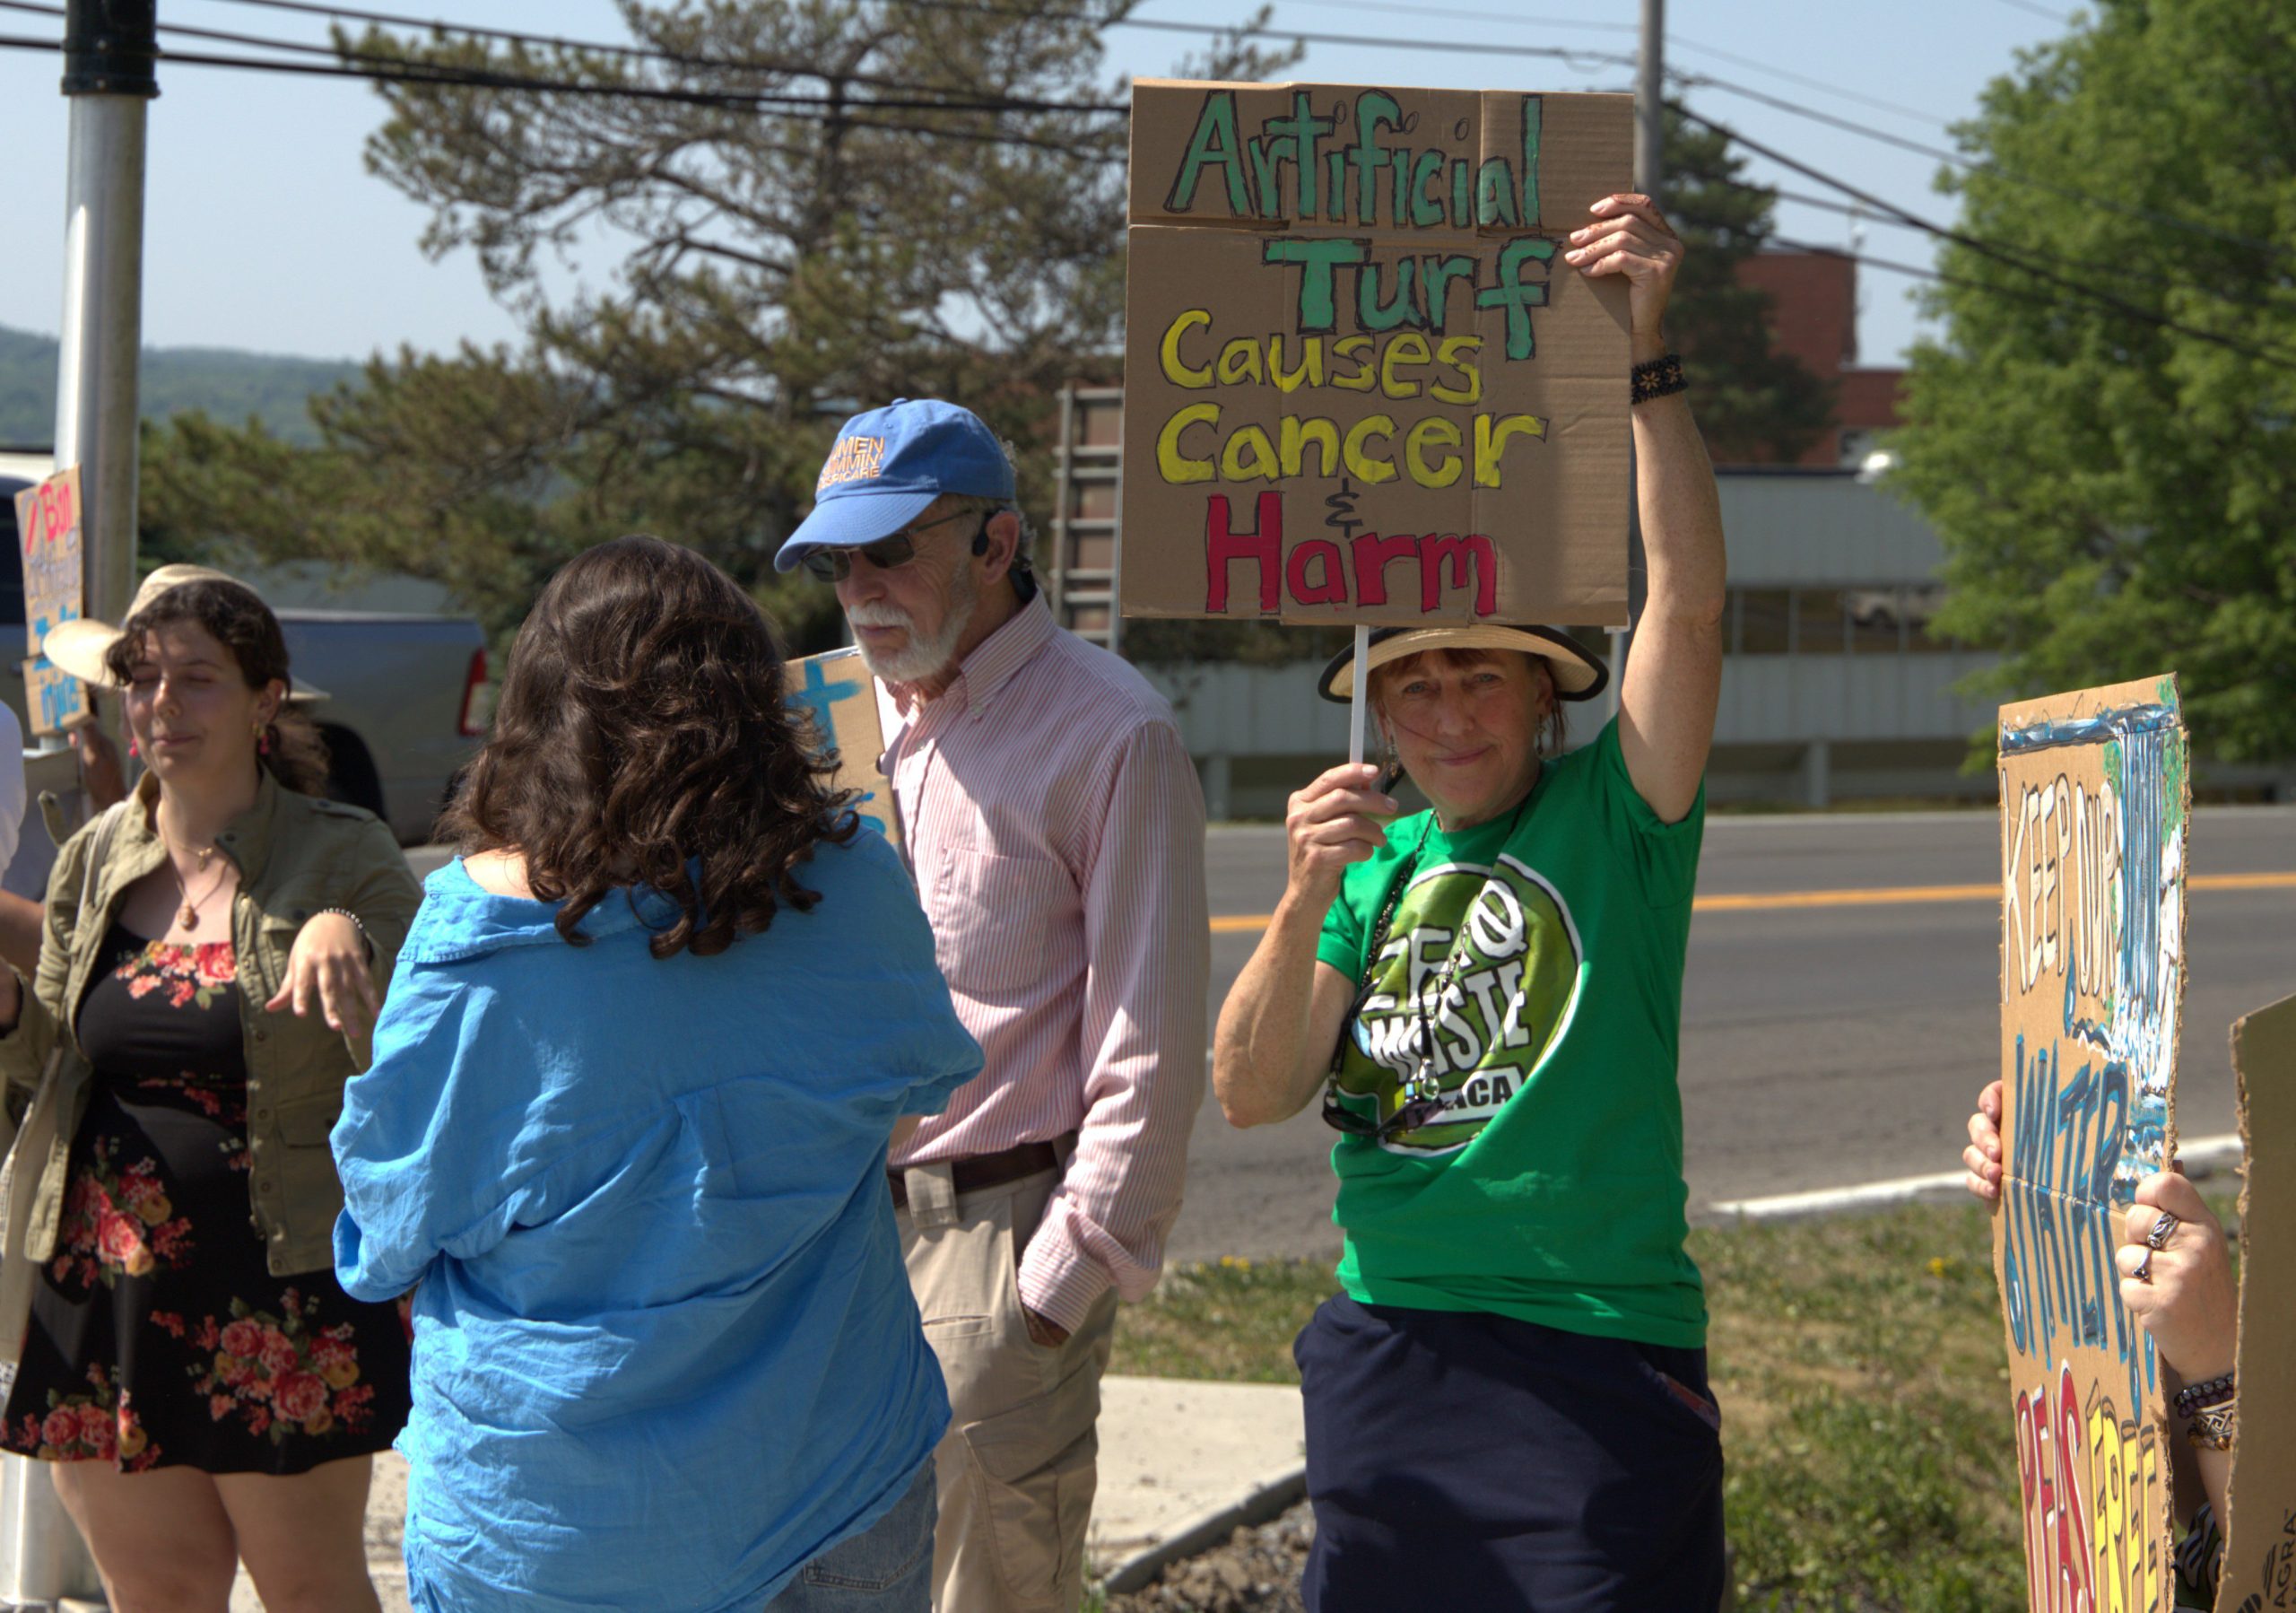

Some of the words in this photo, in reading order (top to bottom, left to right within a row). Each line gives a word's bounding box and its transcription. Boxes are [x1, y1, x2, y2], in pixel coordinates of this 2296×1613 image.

[1163, 90, 1544, 229] Artificial
[1159, 309, 1485, 405] Causes
[1262, 236, 1563, 361] Turf
[1156, 401, 1549, 489] Cancer
[1205, 491, 1498, 615] Harm
[1325, 478, 1362, 538] &
[2002, 767, 2072, 1005] KEEP
[2075, 778, 2117, 1008] OUR
[2012, 1033, 2128, 1371] WATER
